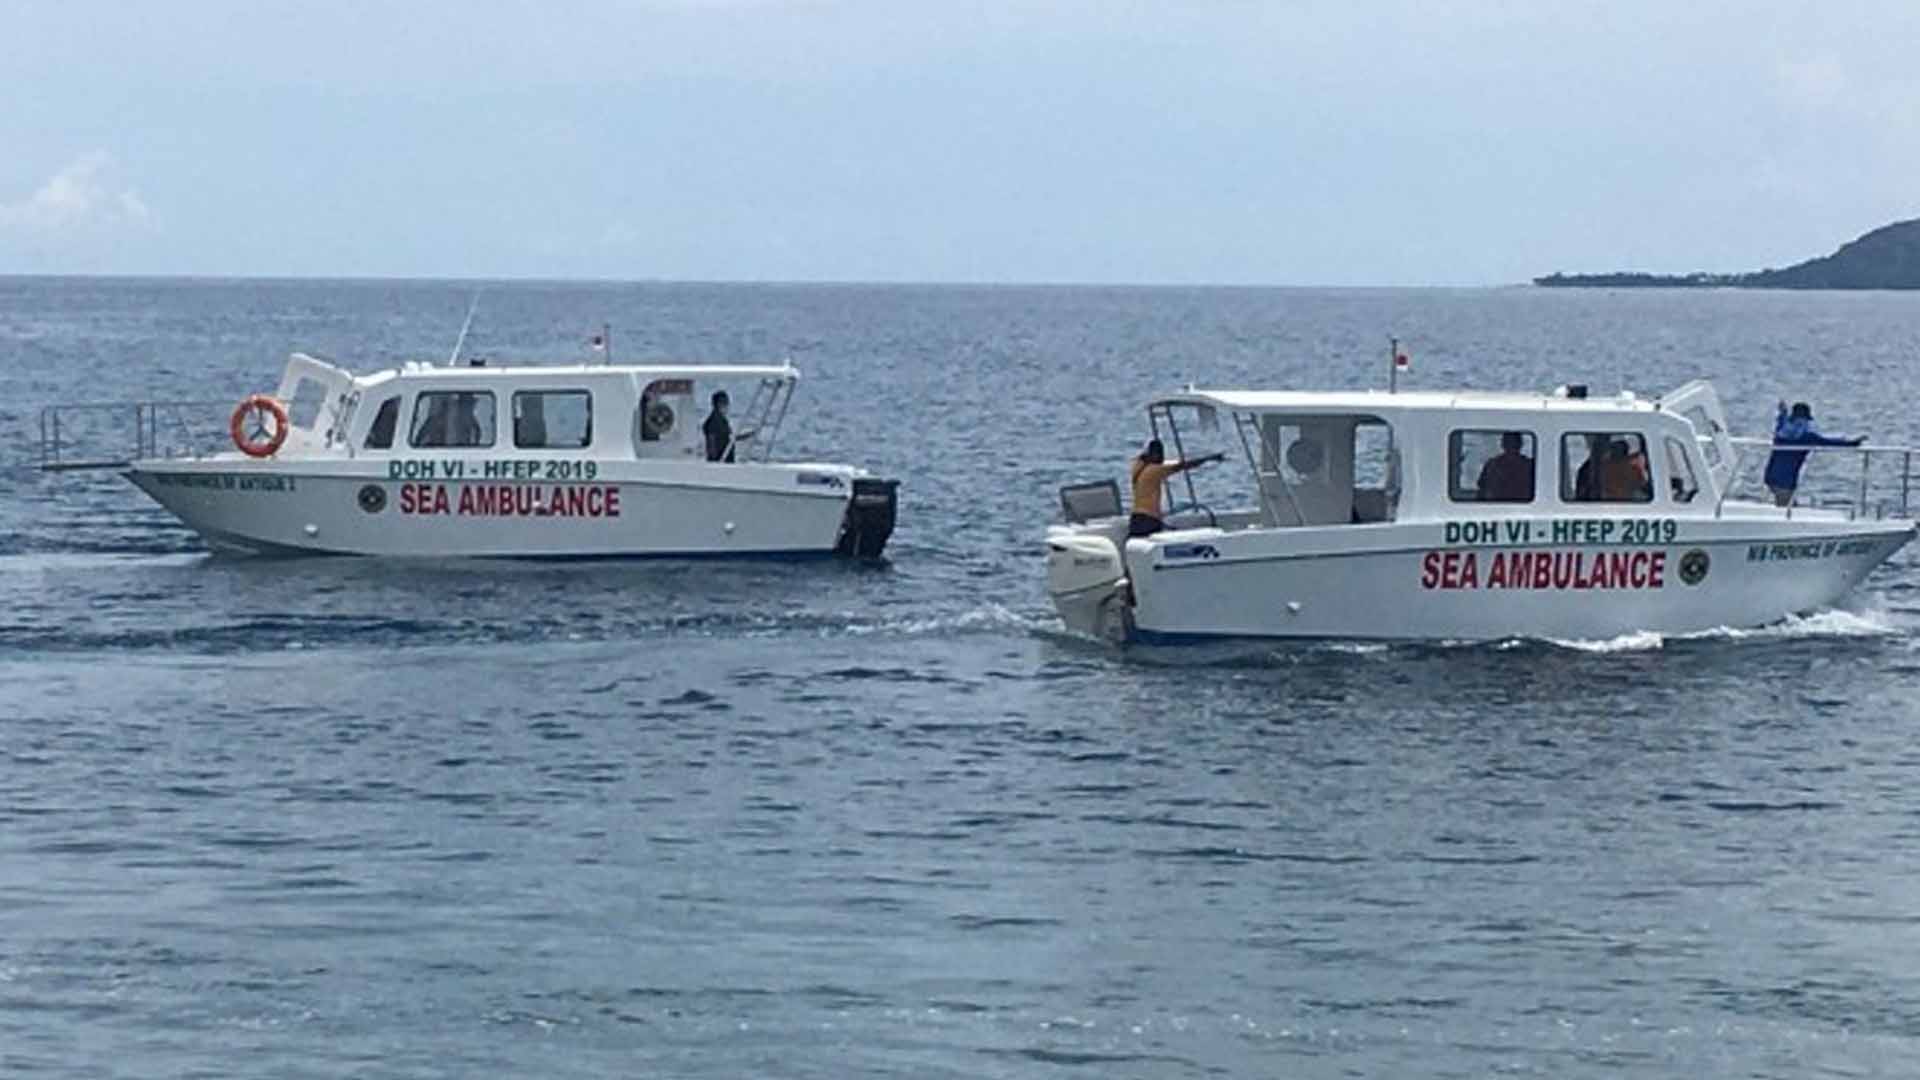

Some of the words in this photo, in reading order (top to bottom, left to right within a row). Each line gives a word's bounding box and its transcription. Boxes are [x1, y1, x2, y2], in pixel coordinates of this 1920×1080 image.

[388, 460, 435, 480] DOH
[442, 460, 464, 480] VI
[484, 461, 541, 480] HFEP
[545, 461, 597, 479] 2019
[400, 484, 450, 515] SEA
[458, 485, 620, 517] AMBULANCE
[1445, 521, 1498, 543] DOH
[1506, 521, 1530, 542] VI
[1552, 520, 1614, 542] HFEP
[1621, 519, 1677, 542] 2019
[1421, 552, 1478, 589] SEA
[1486, 551, 1666, 589] AMBULANCE
